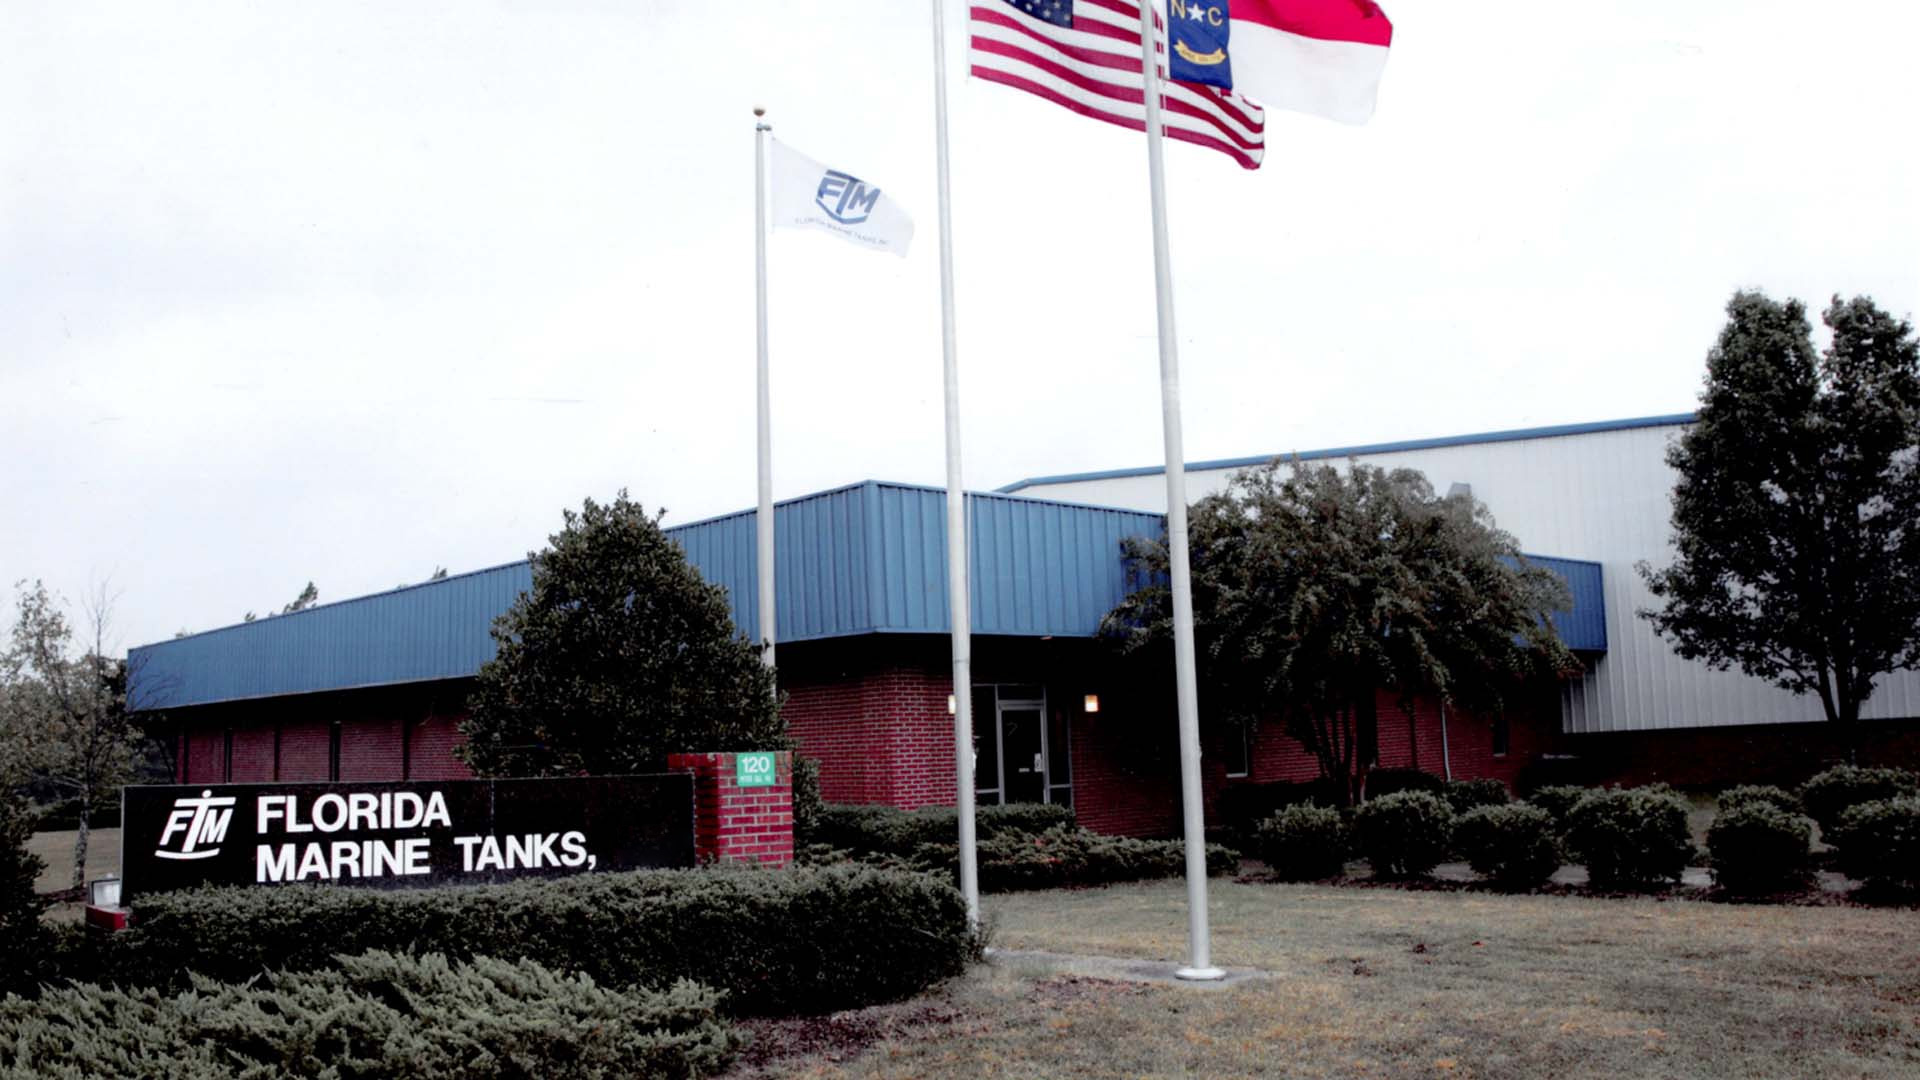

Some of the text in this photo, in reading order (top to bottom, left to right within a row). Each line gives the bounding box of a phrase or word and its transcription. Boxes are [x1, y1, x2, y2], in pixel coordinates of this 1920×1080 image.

[1207, 6, 1222, 26] C
[817, 169, 881, 216] FTM
[742, 756, 770, 773] 120
[158, 796, 236, 853] FTM
[257, 791, 451, 834] FLORIDA
[256, 831, 597, 882] MARINE TANKS,
